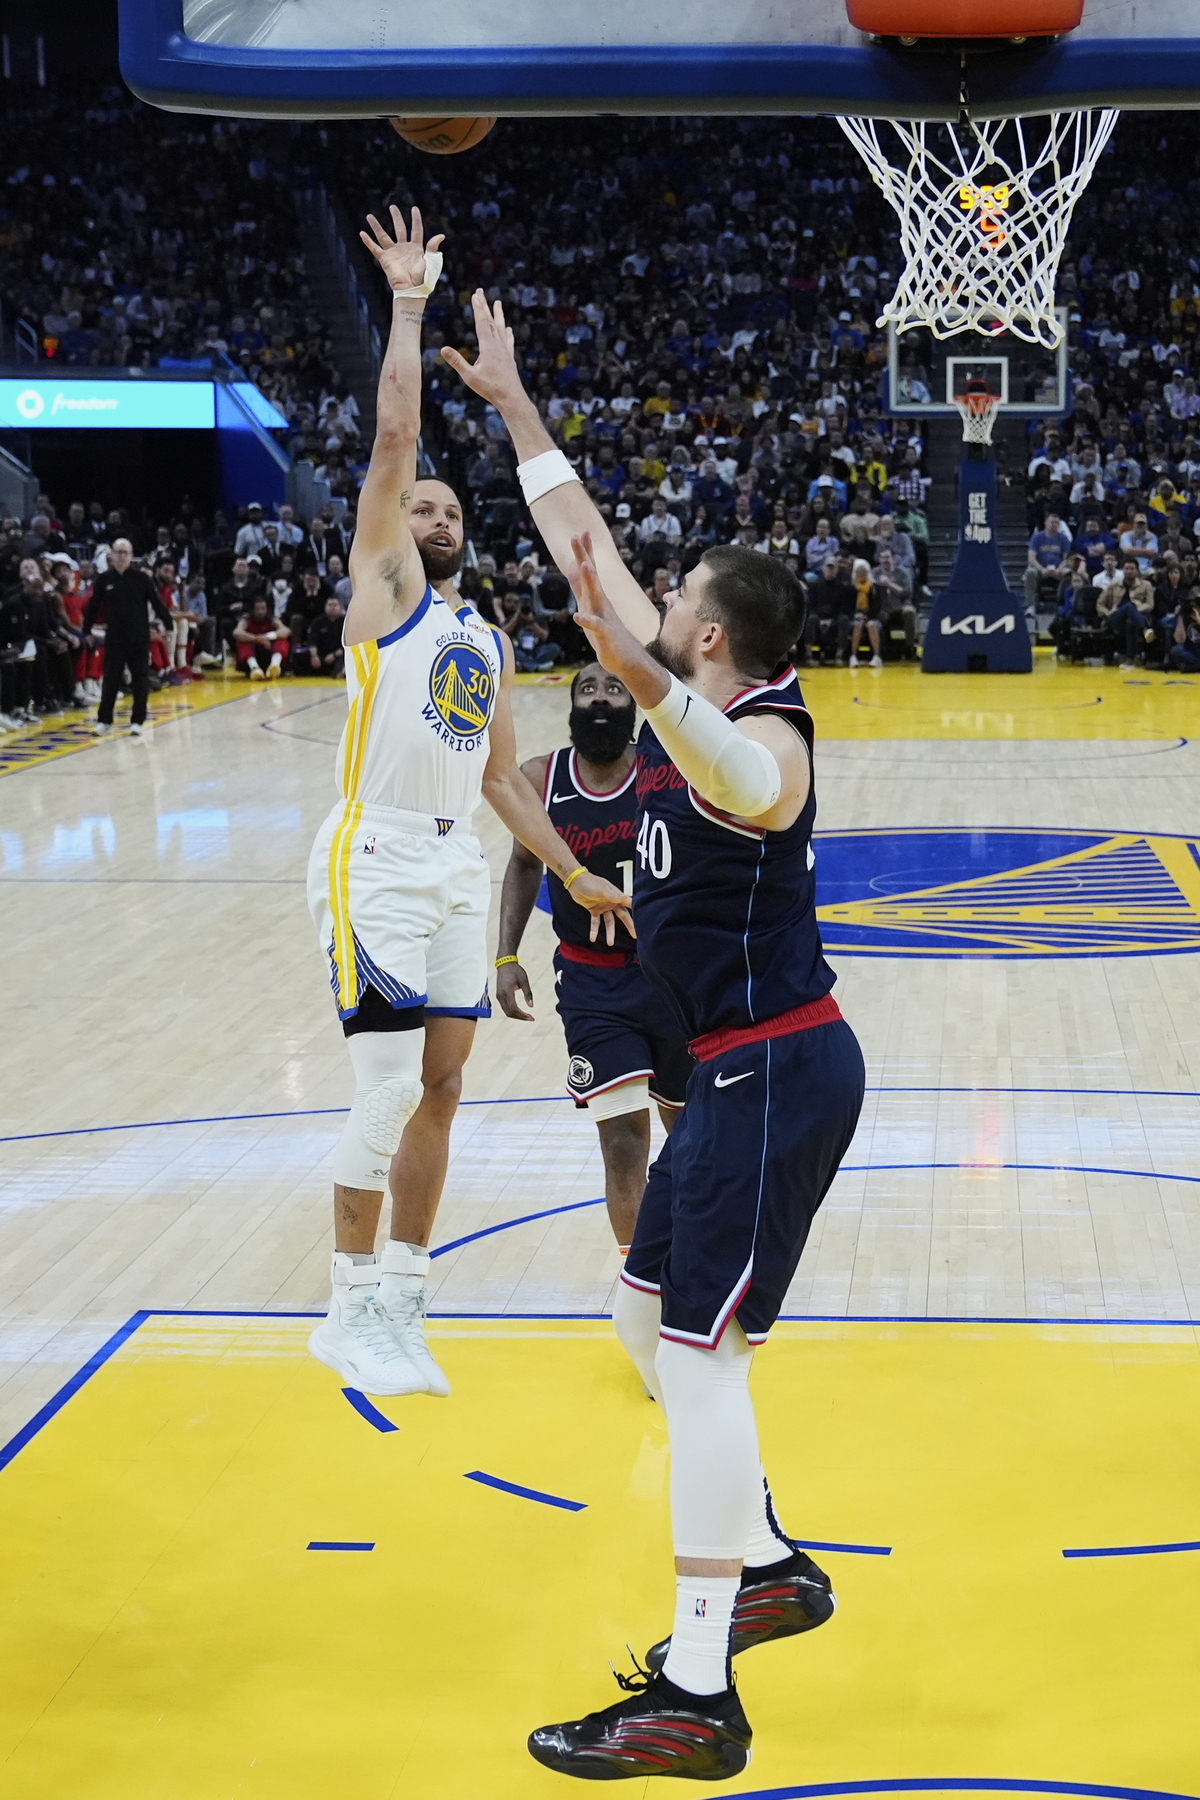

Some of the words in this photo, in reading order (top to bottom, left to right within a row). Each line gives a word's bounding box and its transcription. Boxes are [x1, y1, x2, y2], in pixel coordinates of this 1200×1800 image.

[968, 492, 988, 508] GET
[968, 508, 988, 524] THE
[940, 614, 1016, 635] KIA
[435, 631, 474, 648] GOLDEN
[466, 667, 490, 699] 30
[421, 701, 484, 752] WARRIOR
[635, 810, 673, 879] 40
[615, 859, 634, 897] 1
